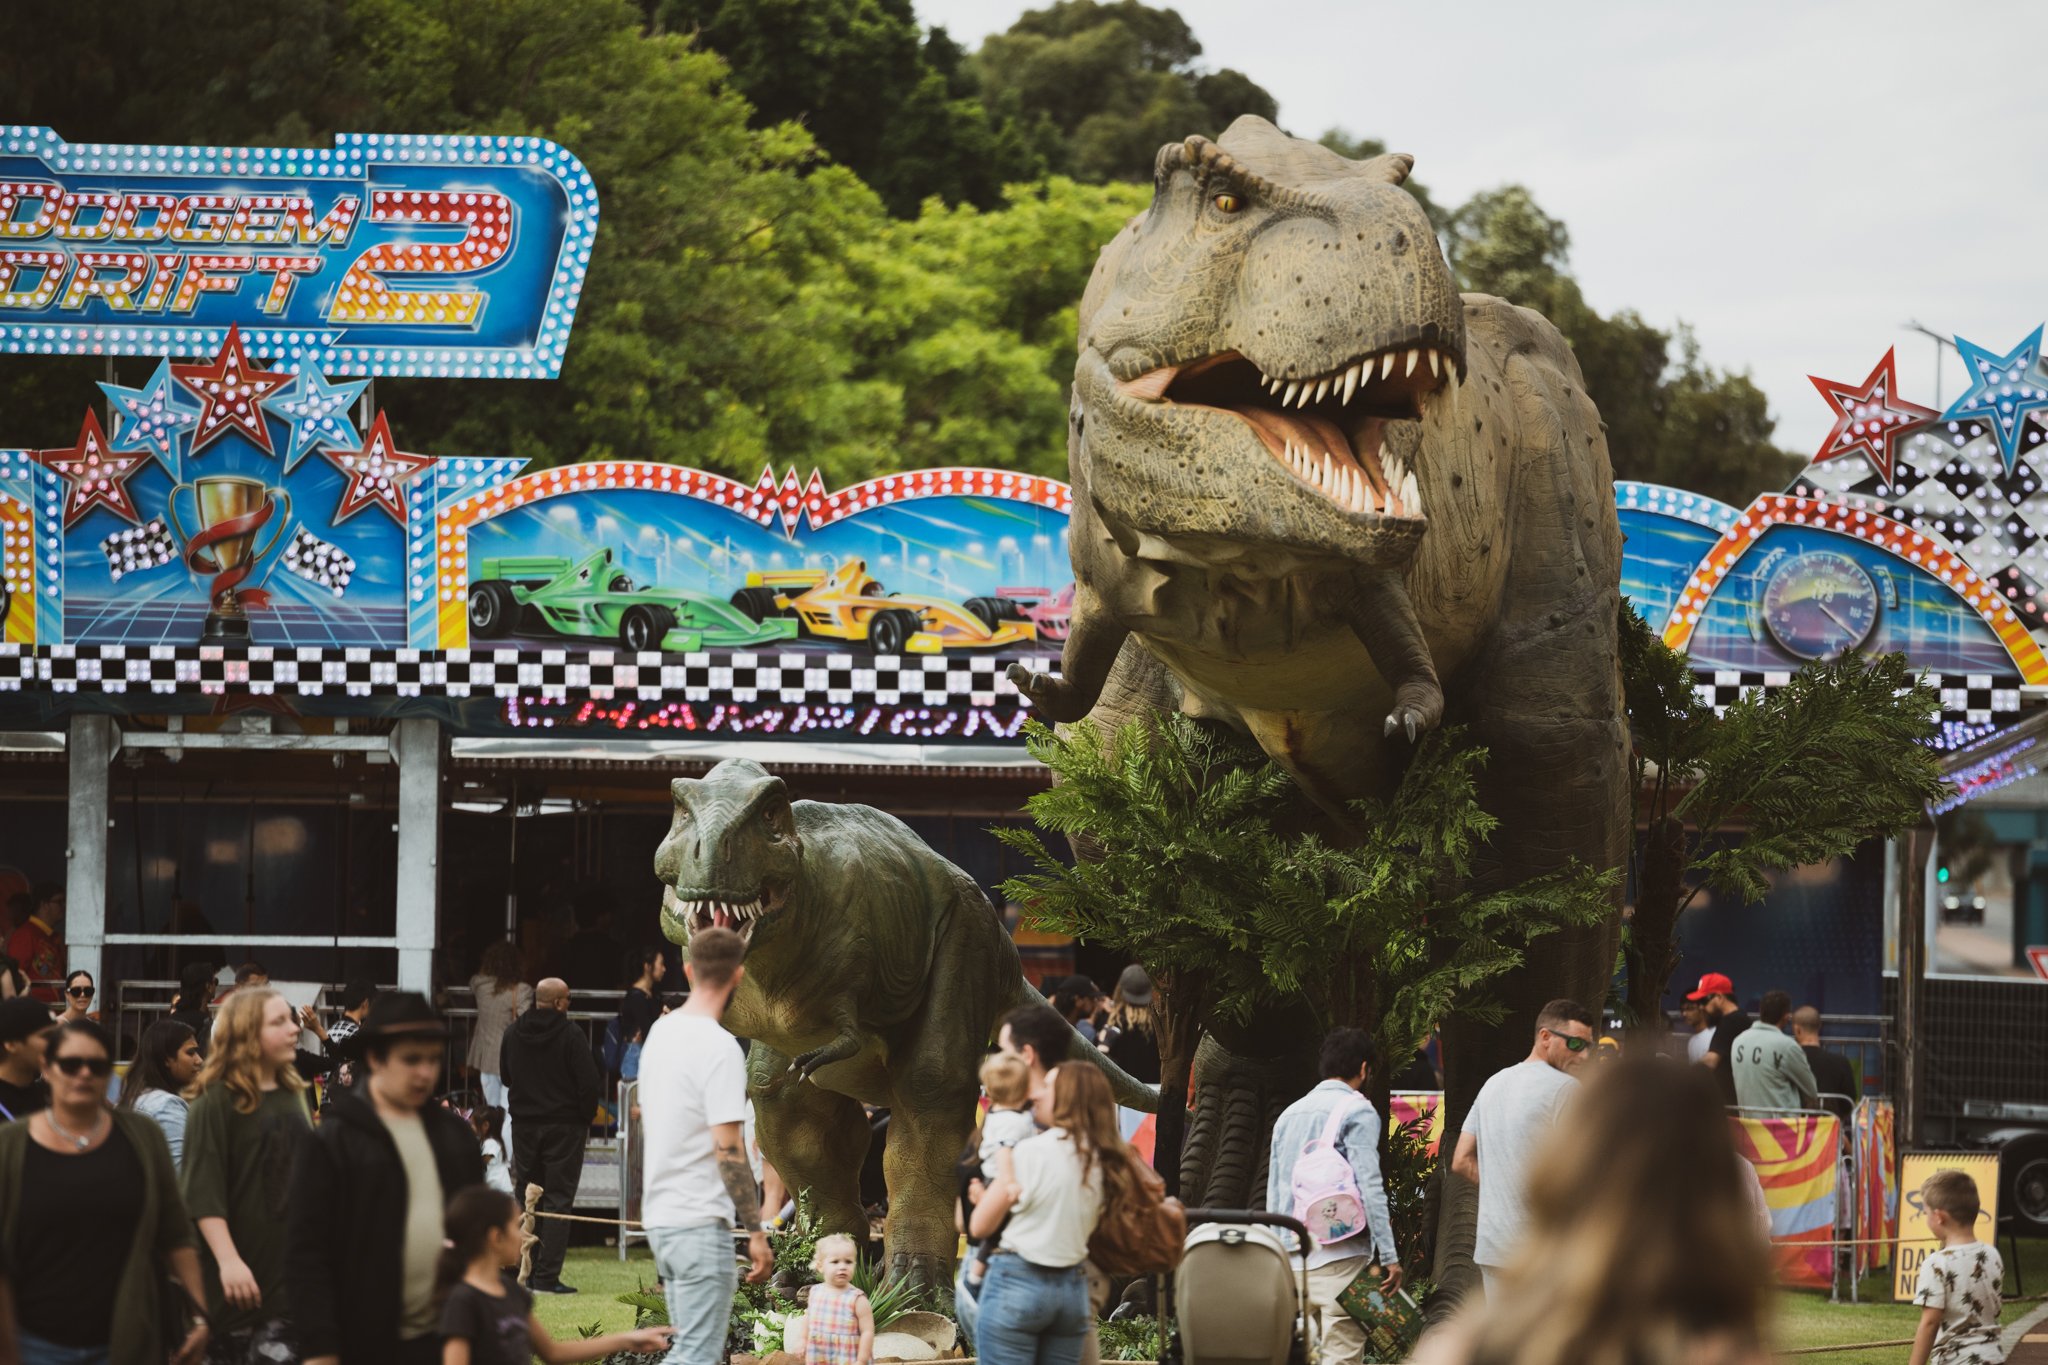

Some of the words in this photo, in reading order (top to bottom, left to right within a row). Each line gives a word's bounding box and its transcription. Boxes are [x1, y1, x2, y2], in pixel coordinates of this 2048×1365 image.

[0, 182, 361, 245] DODGEM
[0, 250, 321, 314] DRIFT
[327, 189, 515, 328] 2
[503, 696, 1031, 737] CHAMPION
